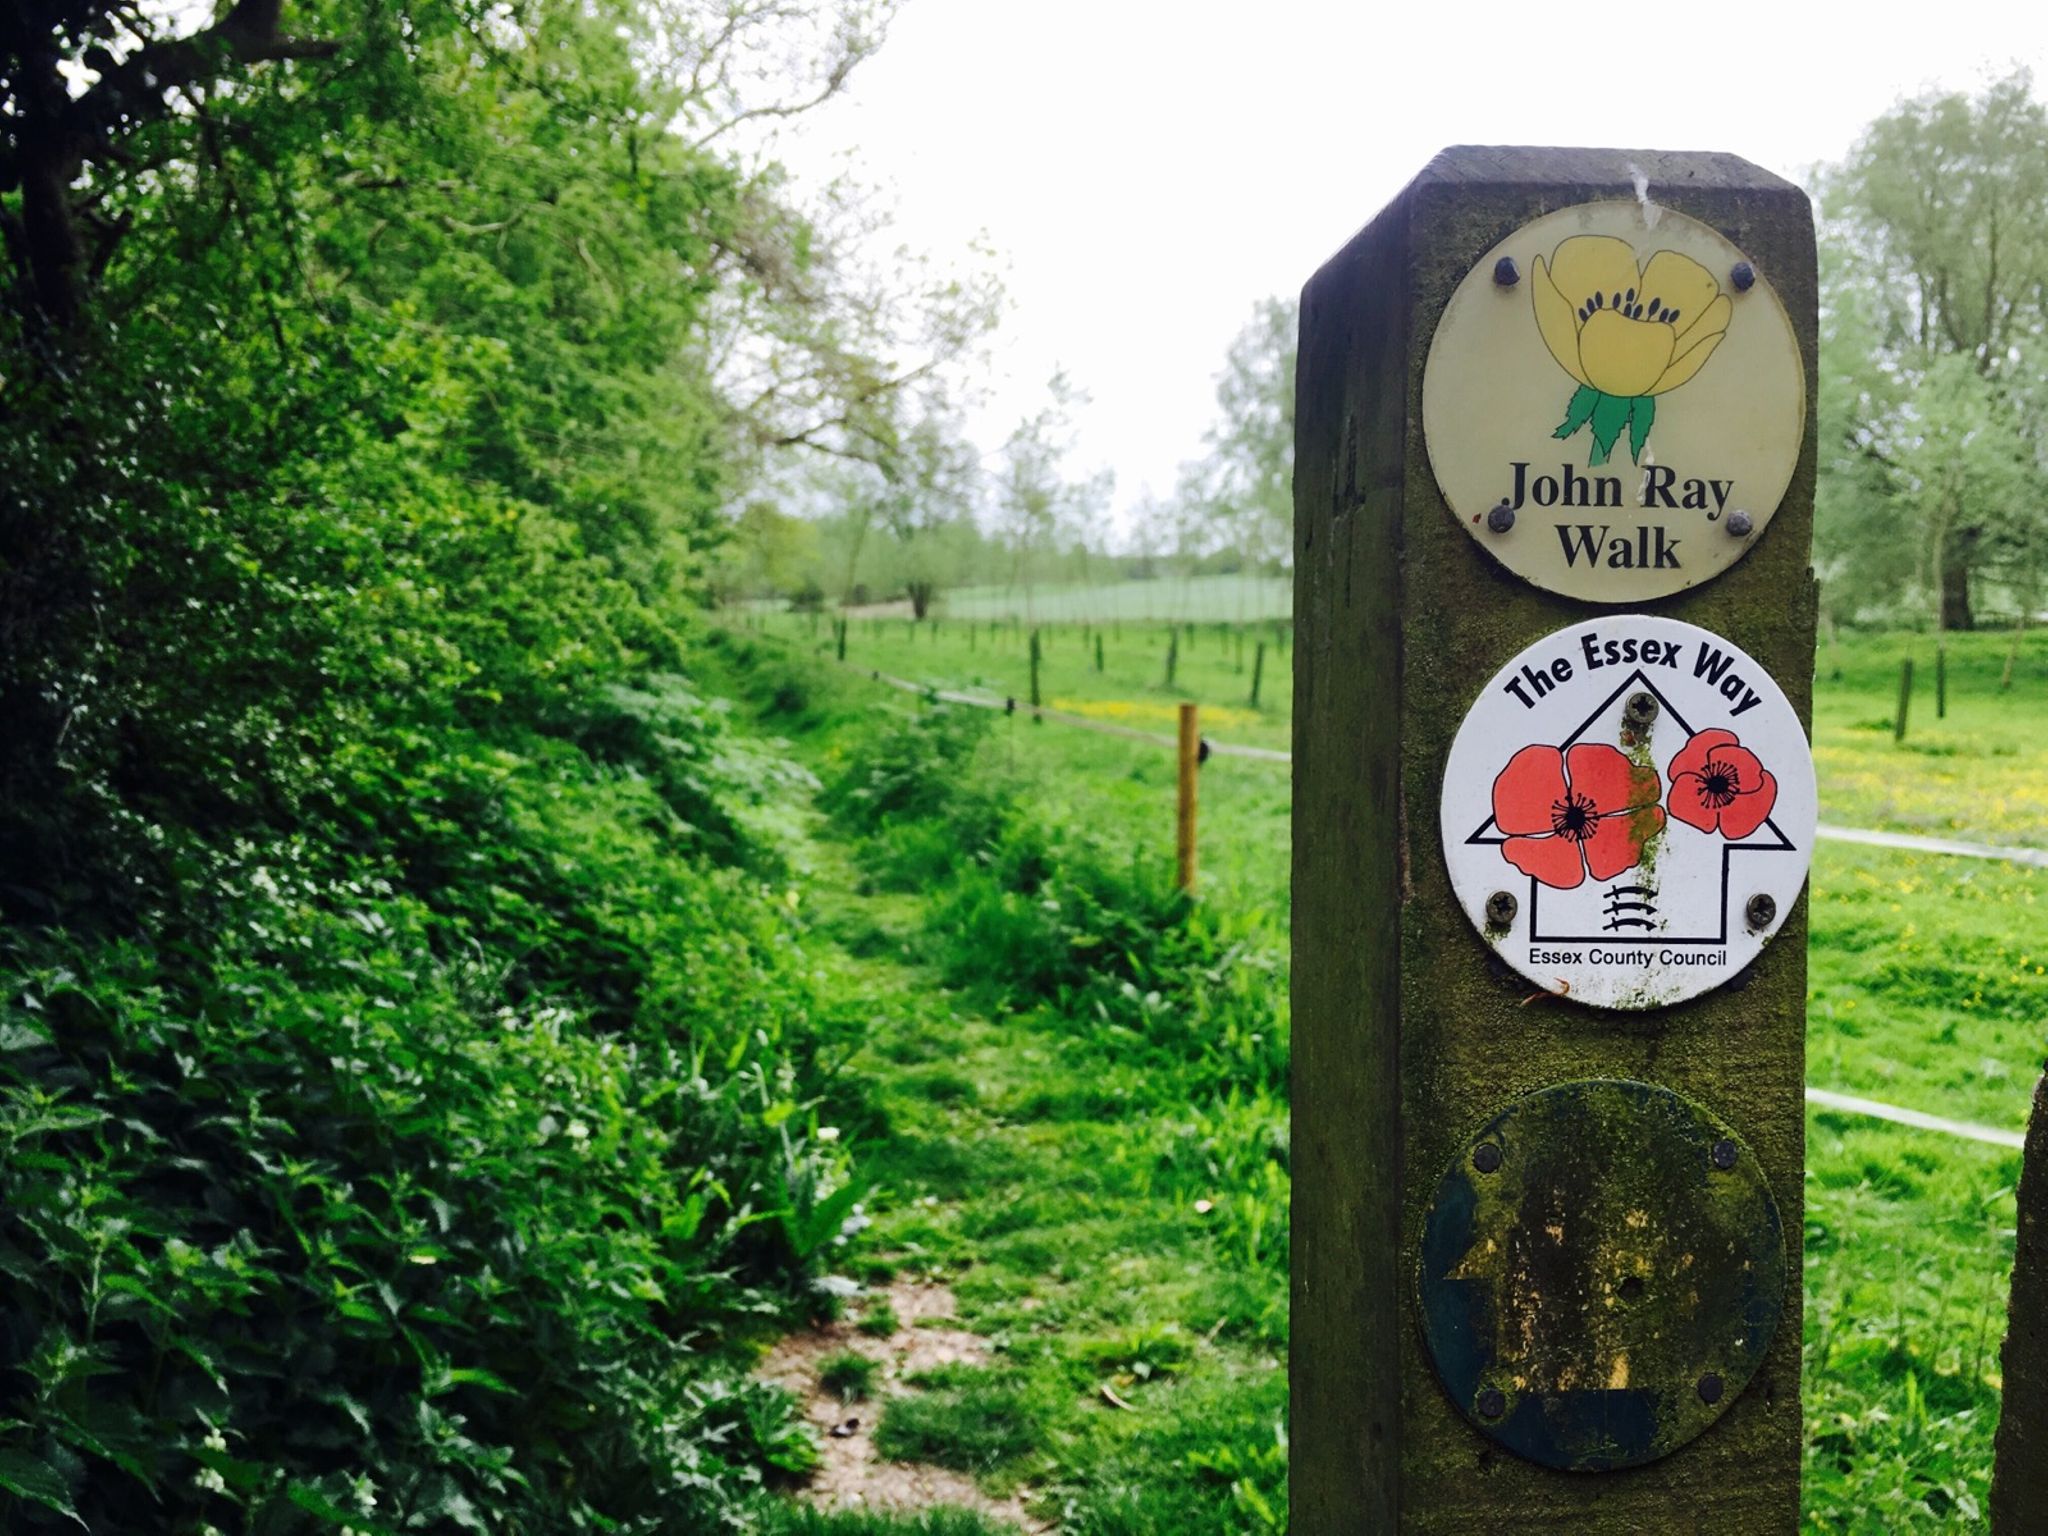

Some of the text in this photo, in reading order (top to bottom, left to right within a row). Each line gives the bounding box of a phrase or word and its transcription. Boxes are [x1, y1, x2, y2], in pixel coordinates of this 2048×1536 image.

[1502, 462, 1734, 520] John Ray
[1555, 525, 1682, 569] Walk
[1503, 633, 1762, 717] The Essex Way
[1529, 949, 1726, 968] Essex County Council
